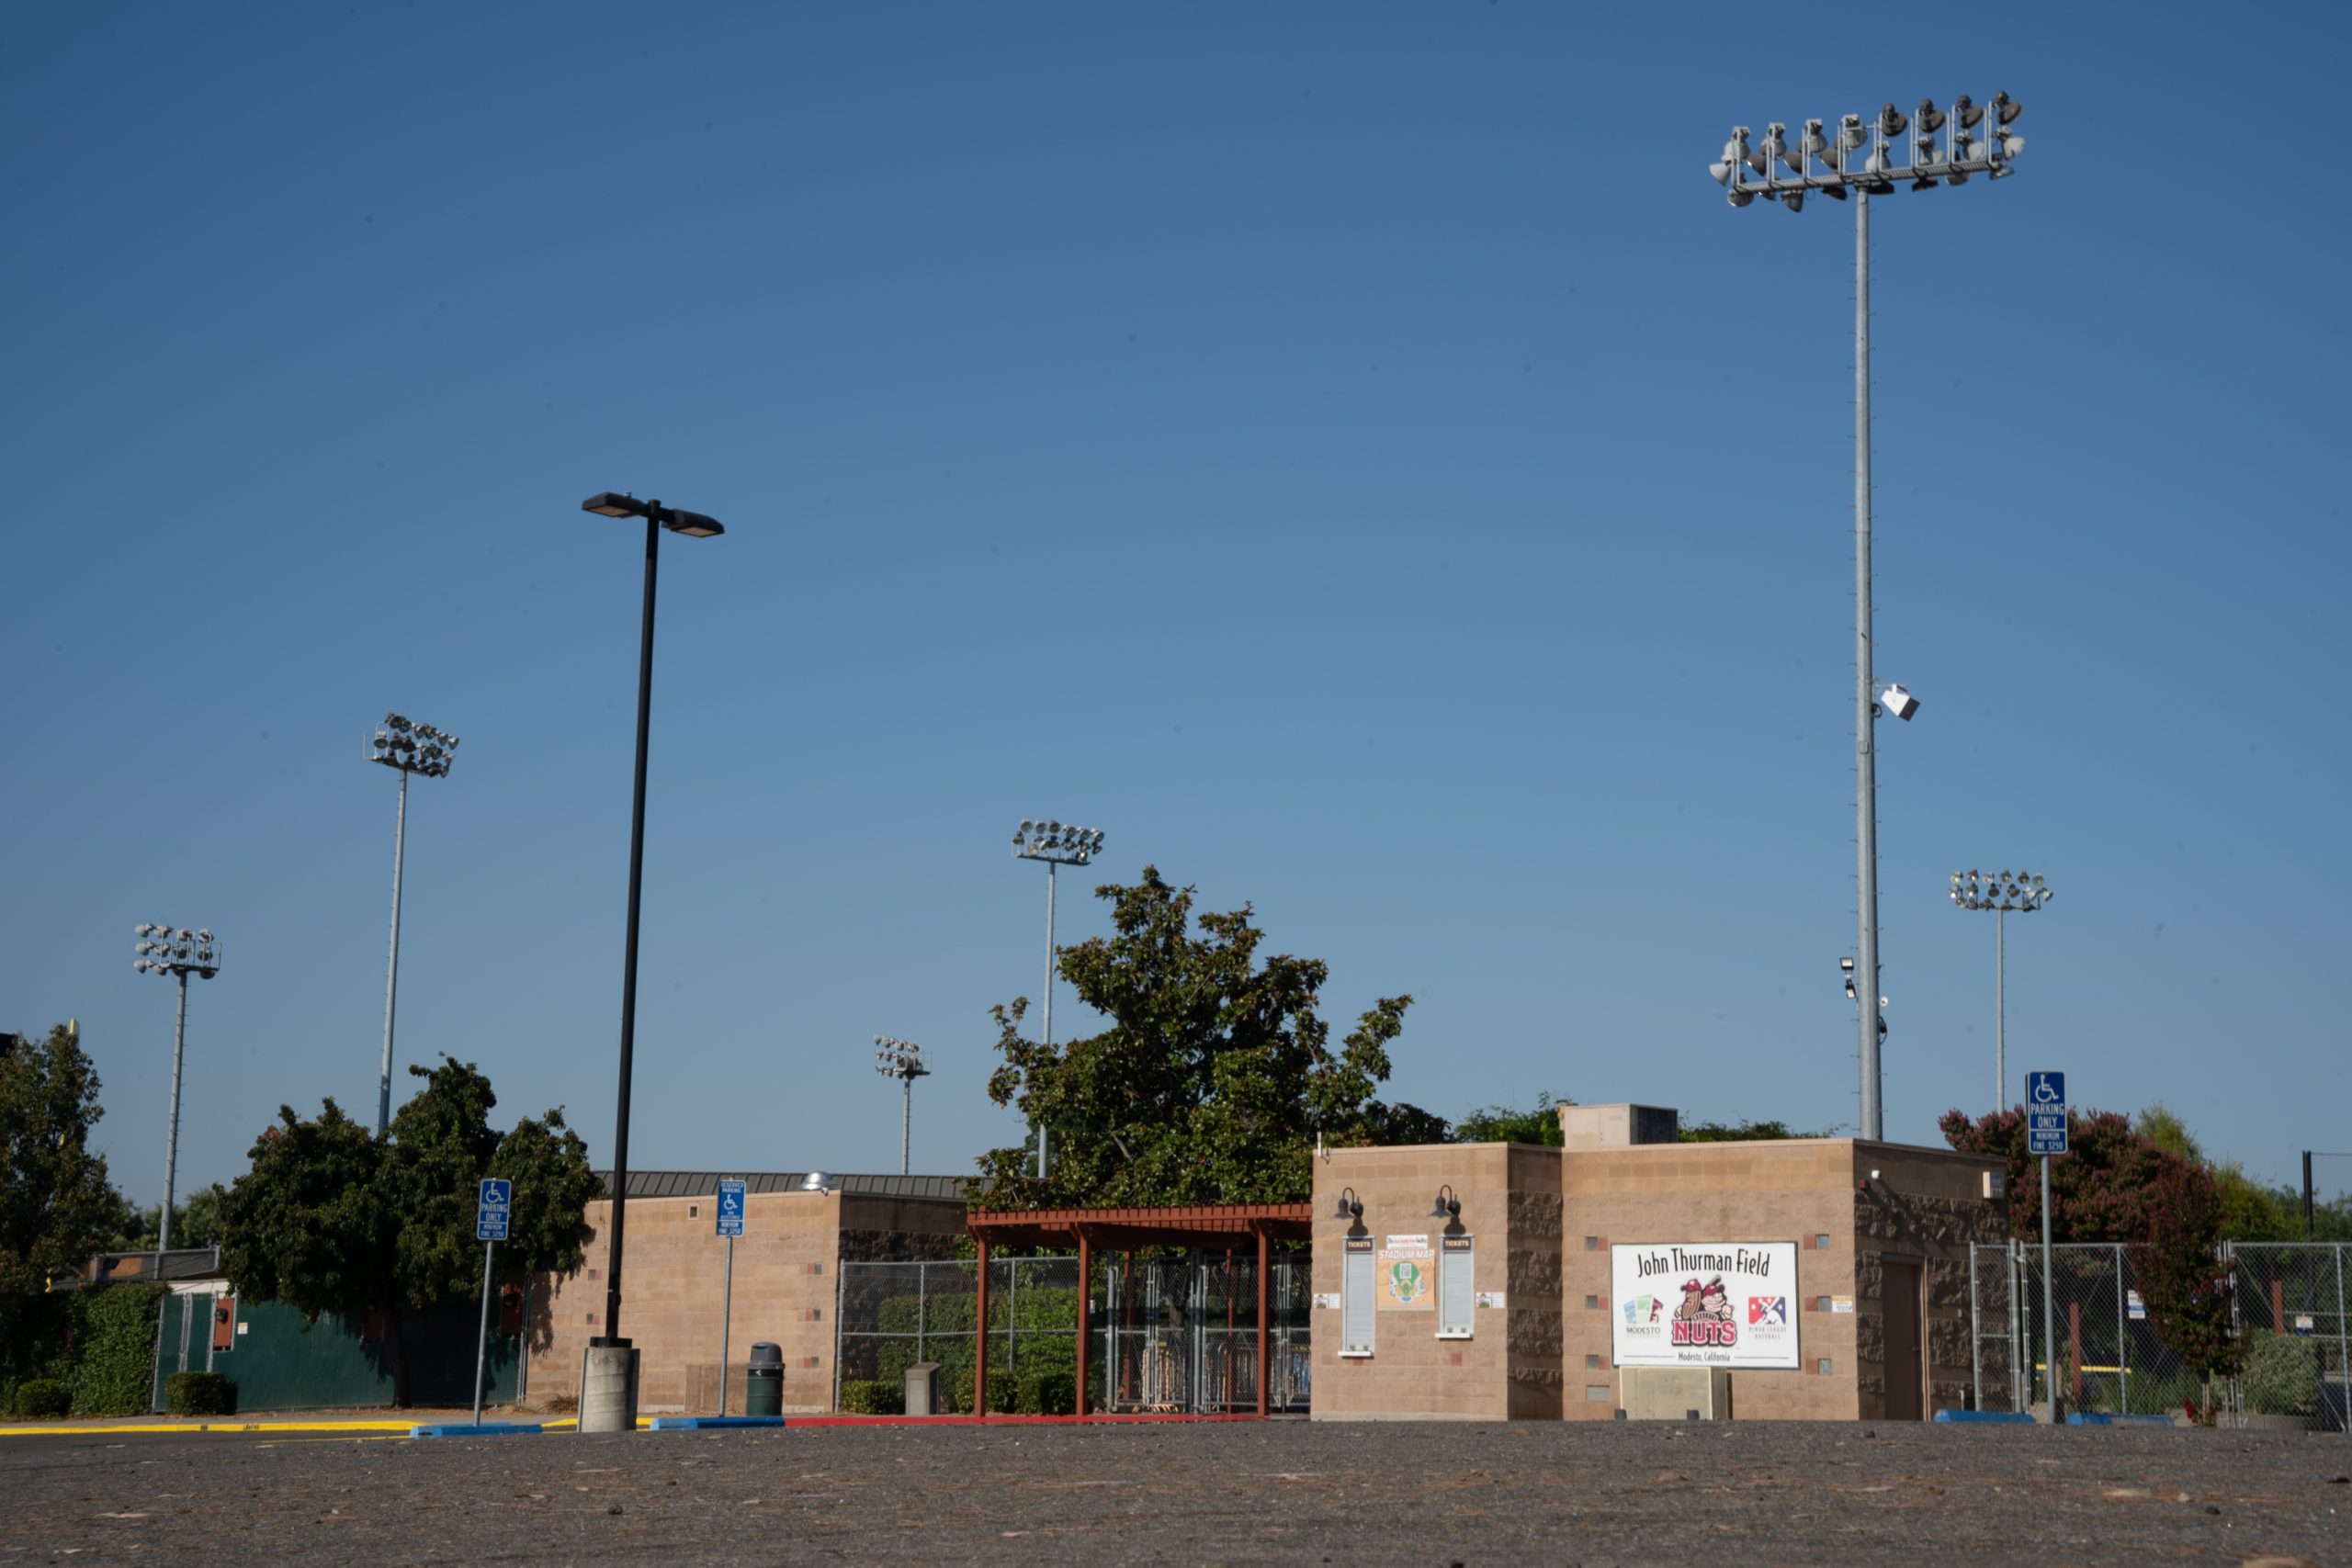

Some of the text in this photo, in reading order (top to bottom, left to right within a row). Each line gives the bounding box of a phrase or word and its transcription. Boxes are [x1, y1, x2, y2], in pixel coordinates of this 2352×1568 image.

[2030, 1103, 2064, 1115] PARKING
[2037, 1116, 2057, 1129] ONLY
[2036, 1132, 2060, 1141] MINIMUM
[2033, 1142, 2064, 1151] FINE $250
[481, 1203, 508, 1213] PARKING
[485, 1213, 502, 1222] ONLY
[1378, 1249, 1434, 1259] STADIUM MAP
[1637, 1247, 1770, 1278] John Thurman Field
[1626, 1325, 1661, 1334] MODESTO
[1672, 1320, 1737, 1347] NUTS
[1678, 1351, 1731, 1362] Modesto, California
